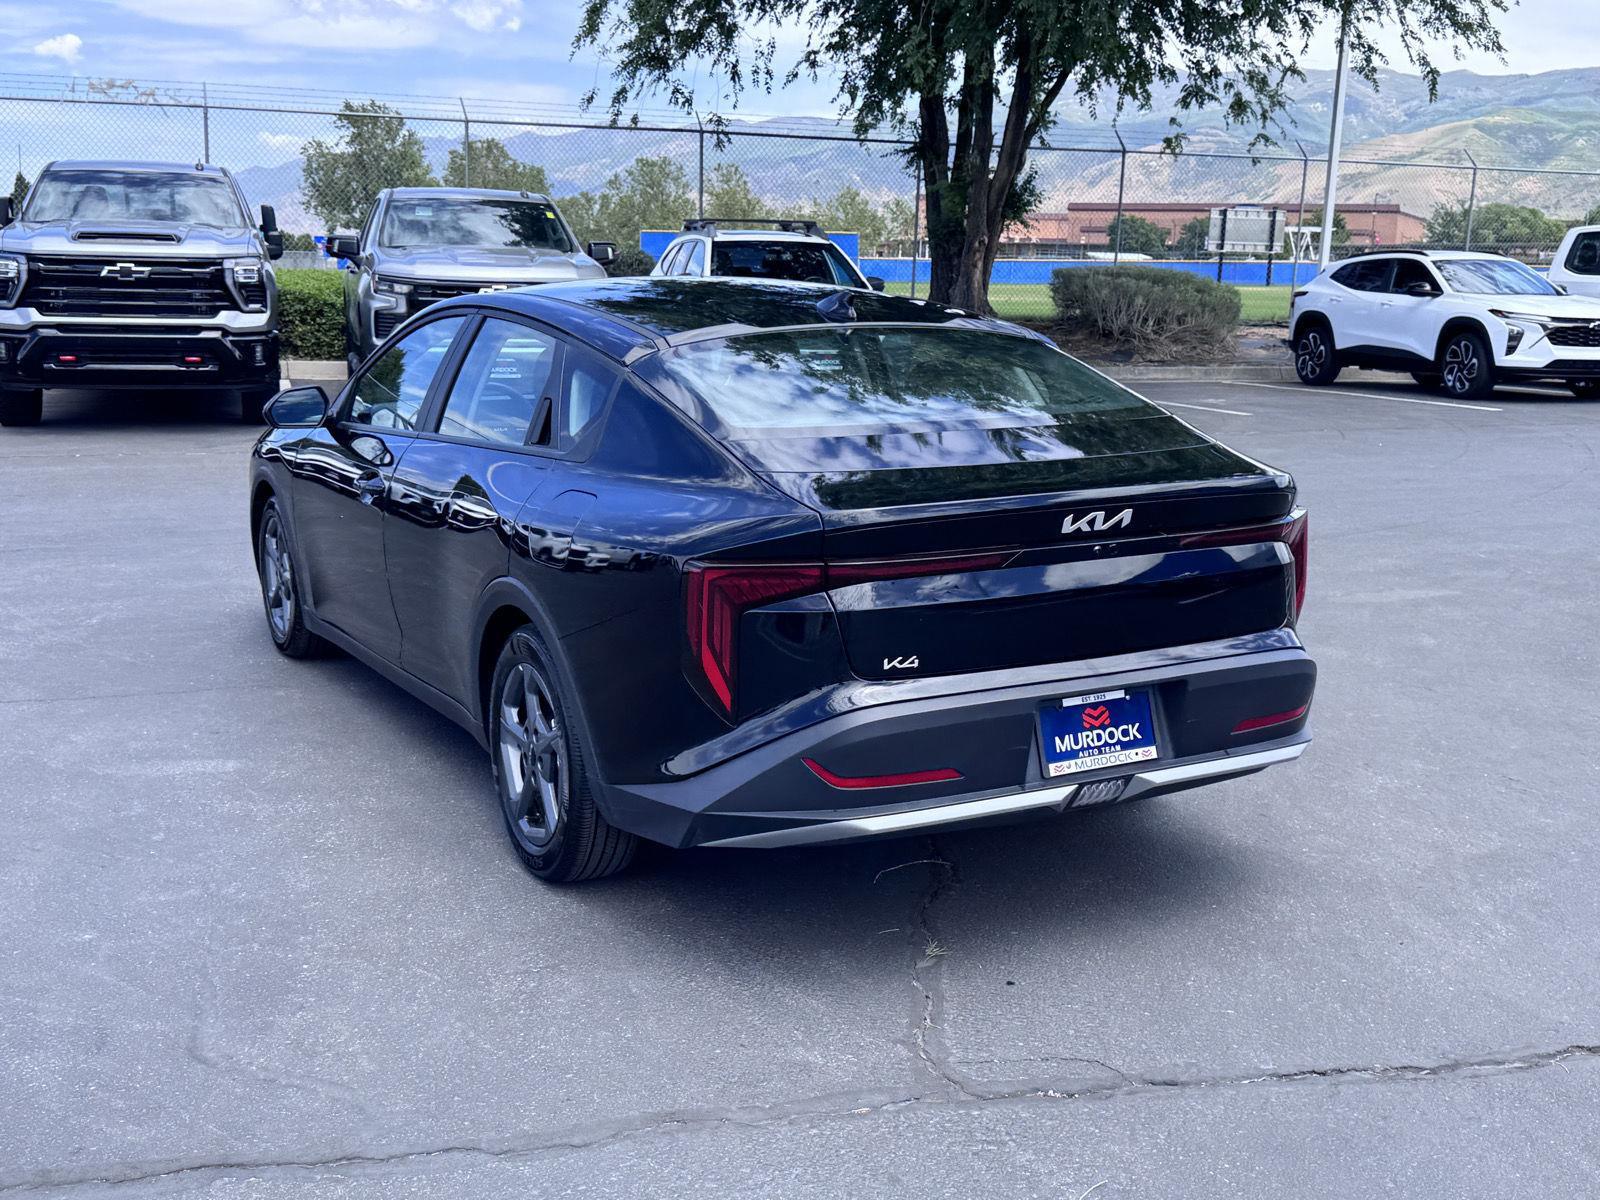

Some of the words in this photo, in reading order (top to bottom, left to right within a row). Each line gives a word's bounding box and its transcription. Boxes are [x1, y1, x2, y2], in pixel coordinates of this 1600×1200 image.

[1061, 508, 1133, 534] KIA
[883, 655, 919, 670] K4
[1054, 722, 1142, 753] MURDOCK
[1078, 748, 1099, 758] AUTO
[1100, 744, 1121, 754] TEAM
[1074, 752, 1133, 770] MURDOCK
